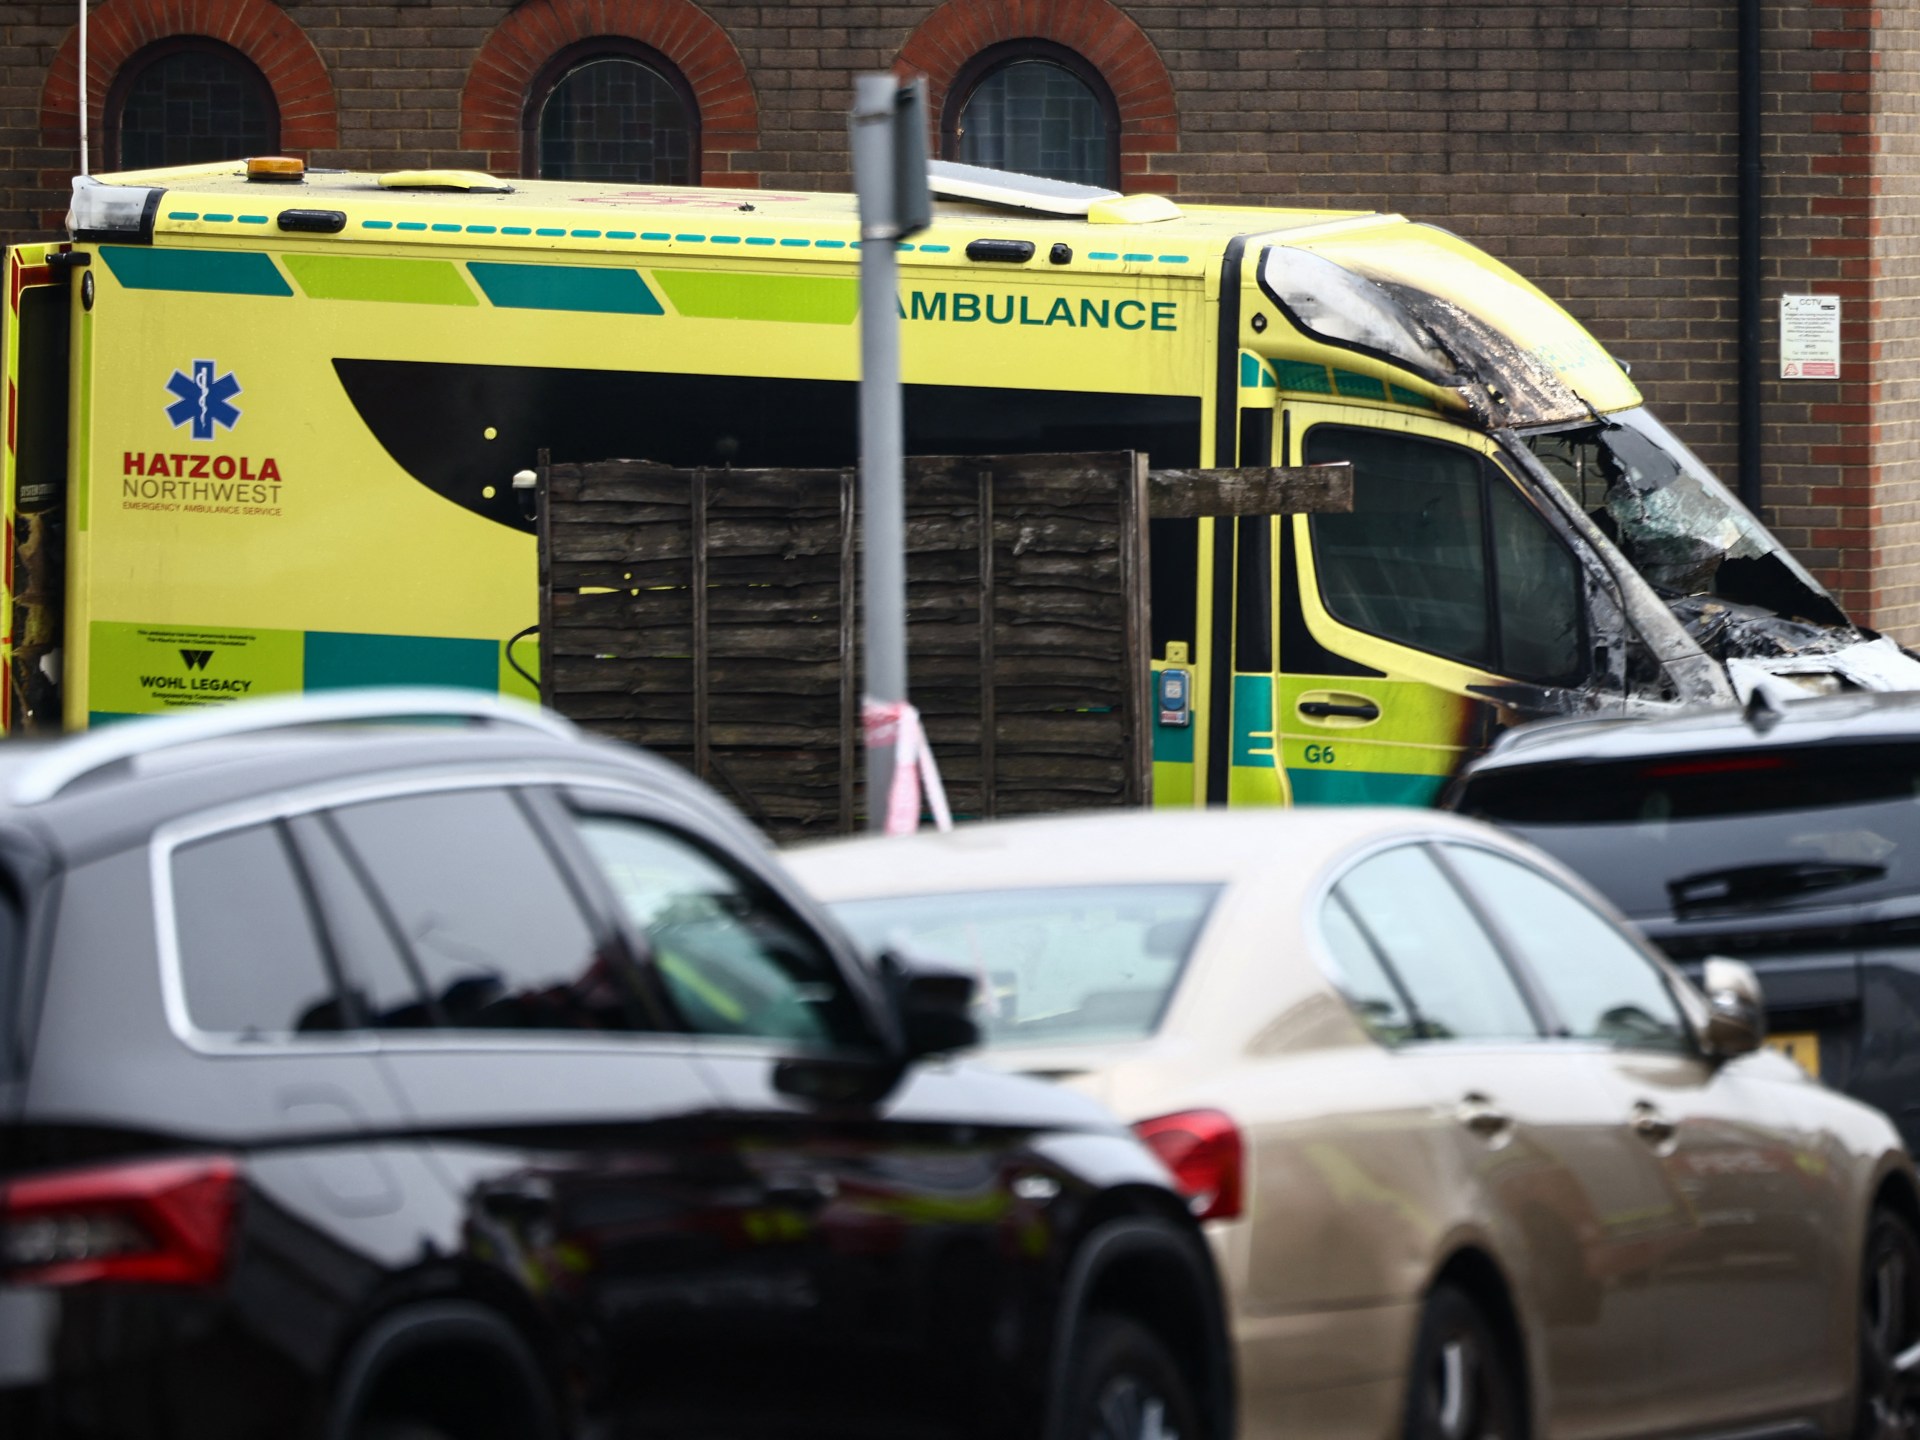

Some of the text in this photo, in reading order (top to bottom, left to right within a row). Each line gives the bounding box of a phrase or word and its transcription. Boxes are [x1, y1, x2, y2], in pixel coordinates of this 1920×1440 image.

[1799, 298, 1822, 306] CCTV
[123, 452, 282, 482] HATZOLA
[122, 479, 282, 504] NORTHWEST
[122, 501, 282, 517] EMERGENCY AMBULANCE SERVICE
[140, 675, 252, 693] WOHL LEGACY
[1303, 744, 1335, 764] G6
